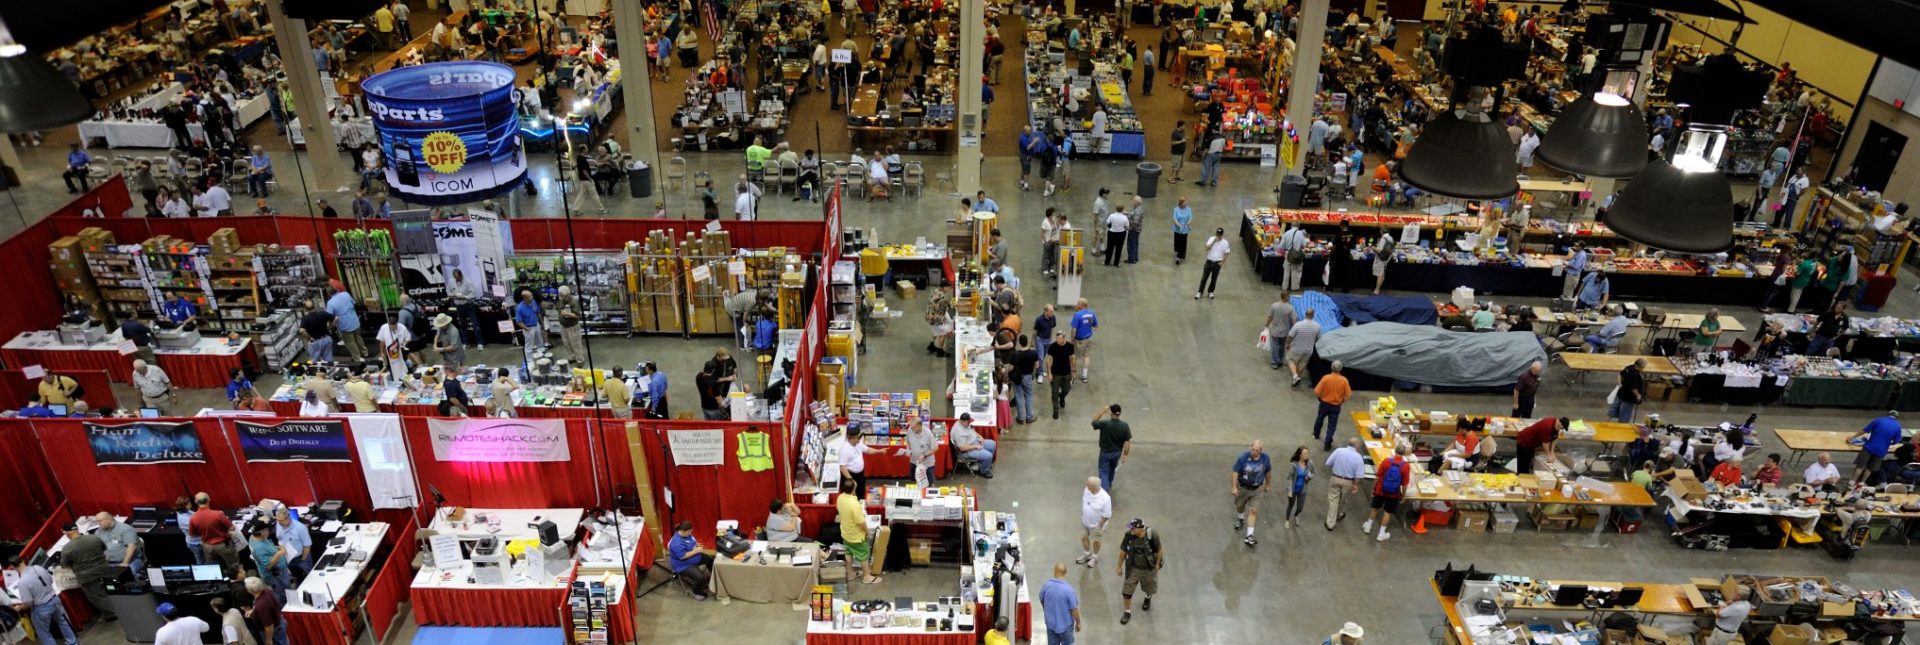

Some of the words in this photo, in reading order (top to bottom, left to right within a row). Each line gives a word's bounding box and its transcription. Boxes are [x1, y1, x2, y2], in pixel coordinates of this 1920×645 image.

[426, 138, 461, 153] 10%
[428, 151, 464, 166] OFF!
[431, 178, 474, 193] ICOM
[470, 213, 497, 223] COMET
[432, 226, 475, 240] COME
[408, 286, 445, 296] COMET
[90, 425, 141, 436] Ham
[277, 424, 329, 433] SOFTWARE
[116, 437, 174, 449] Radio
[134, 449, 204, 461] Deluxe
